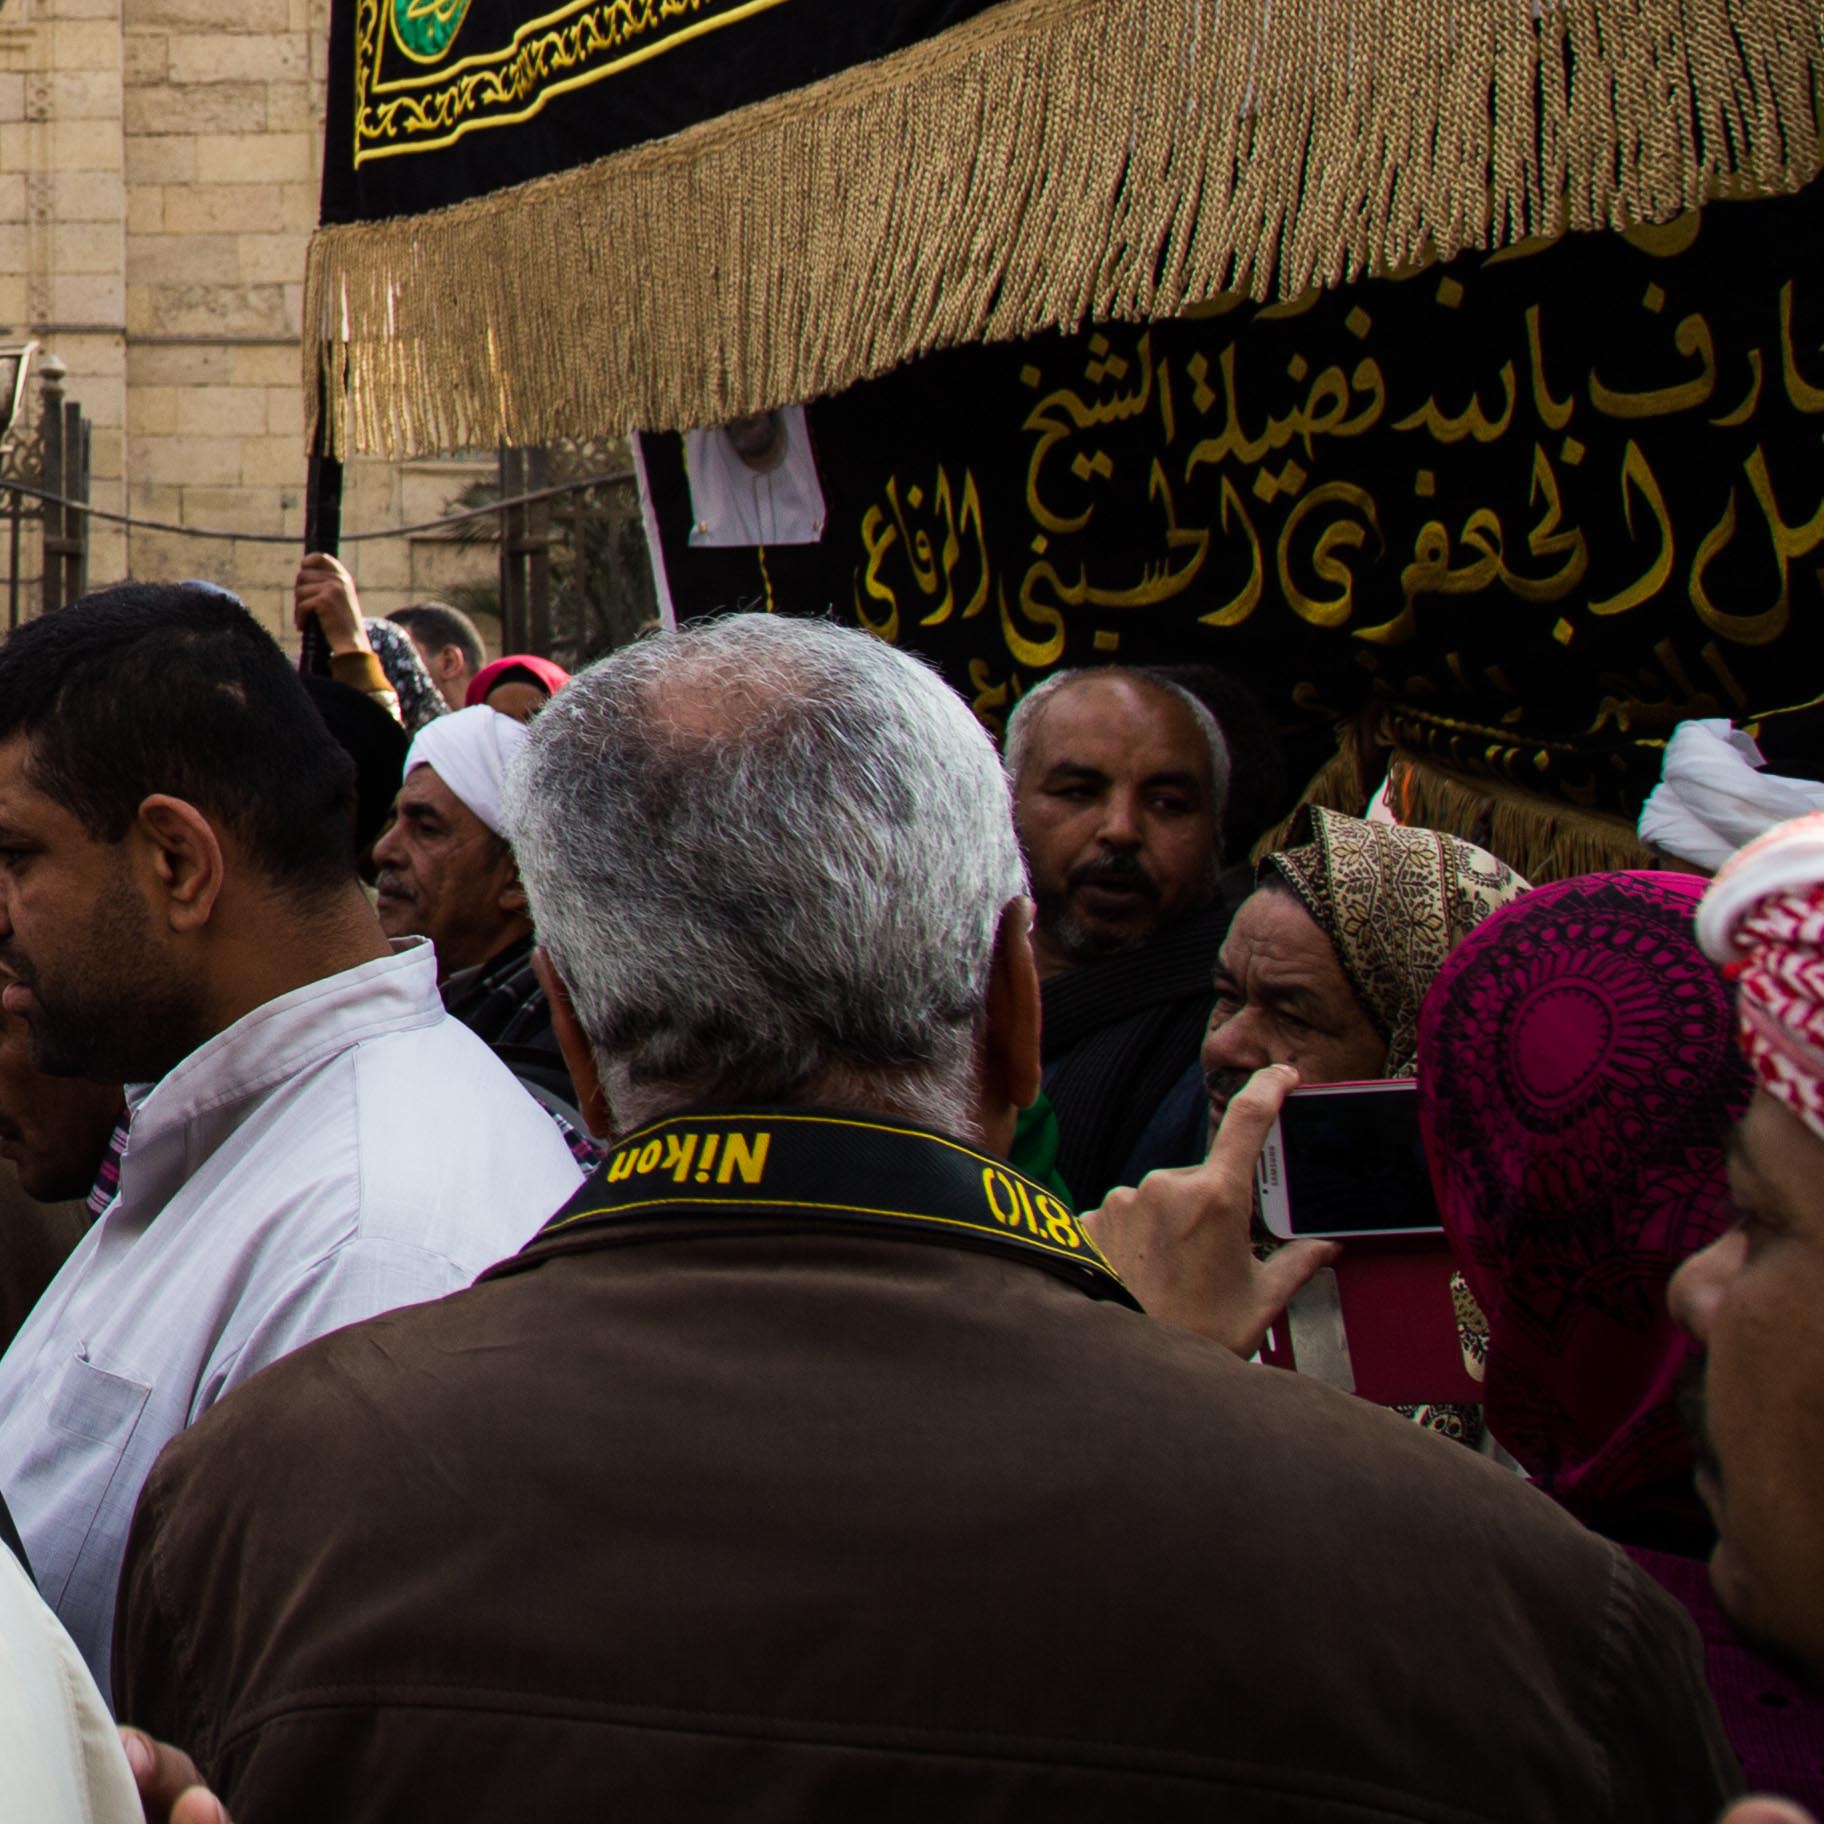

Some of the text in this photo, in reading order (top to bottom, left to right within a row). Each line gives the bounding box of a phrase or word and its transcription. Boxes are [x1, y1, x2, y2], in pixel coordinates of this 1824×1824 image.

[1017, 329, 1178, 536] الشيخ
[1185, 304, 1391, 504] فضيلة
[607, 1132, 772, 1186] Nikon
[1267, 1145, 1280, 1187] SAMSUNG
